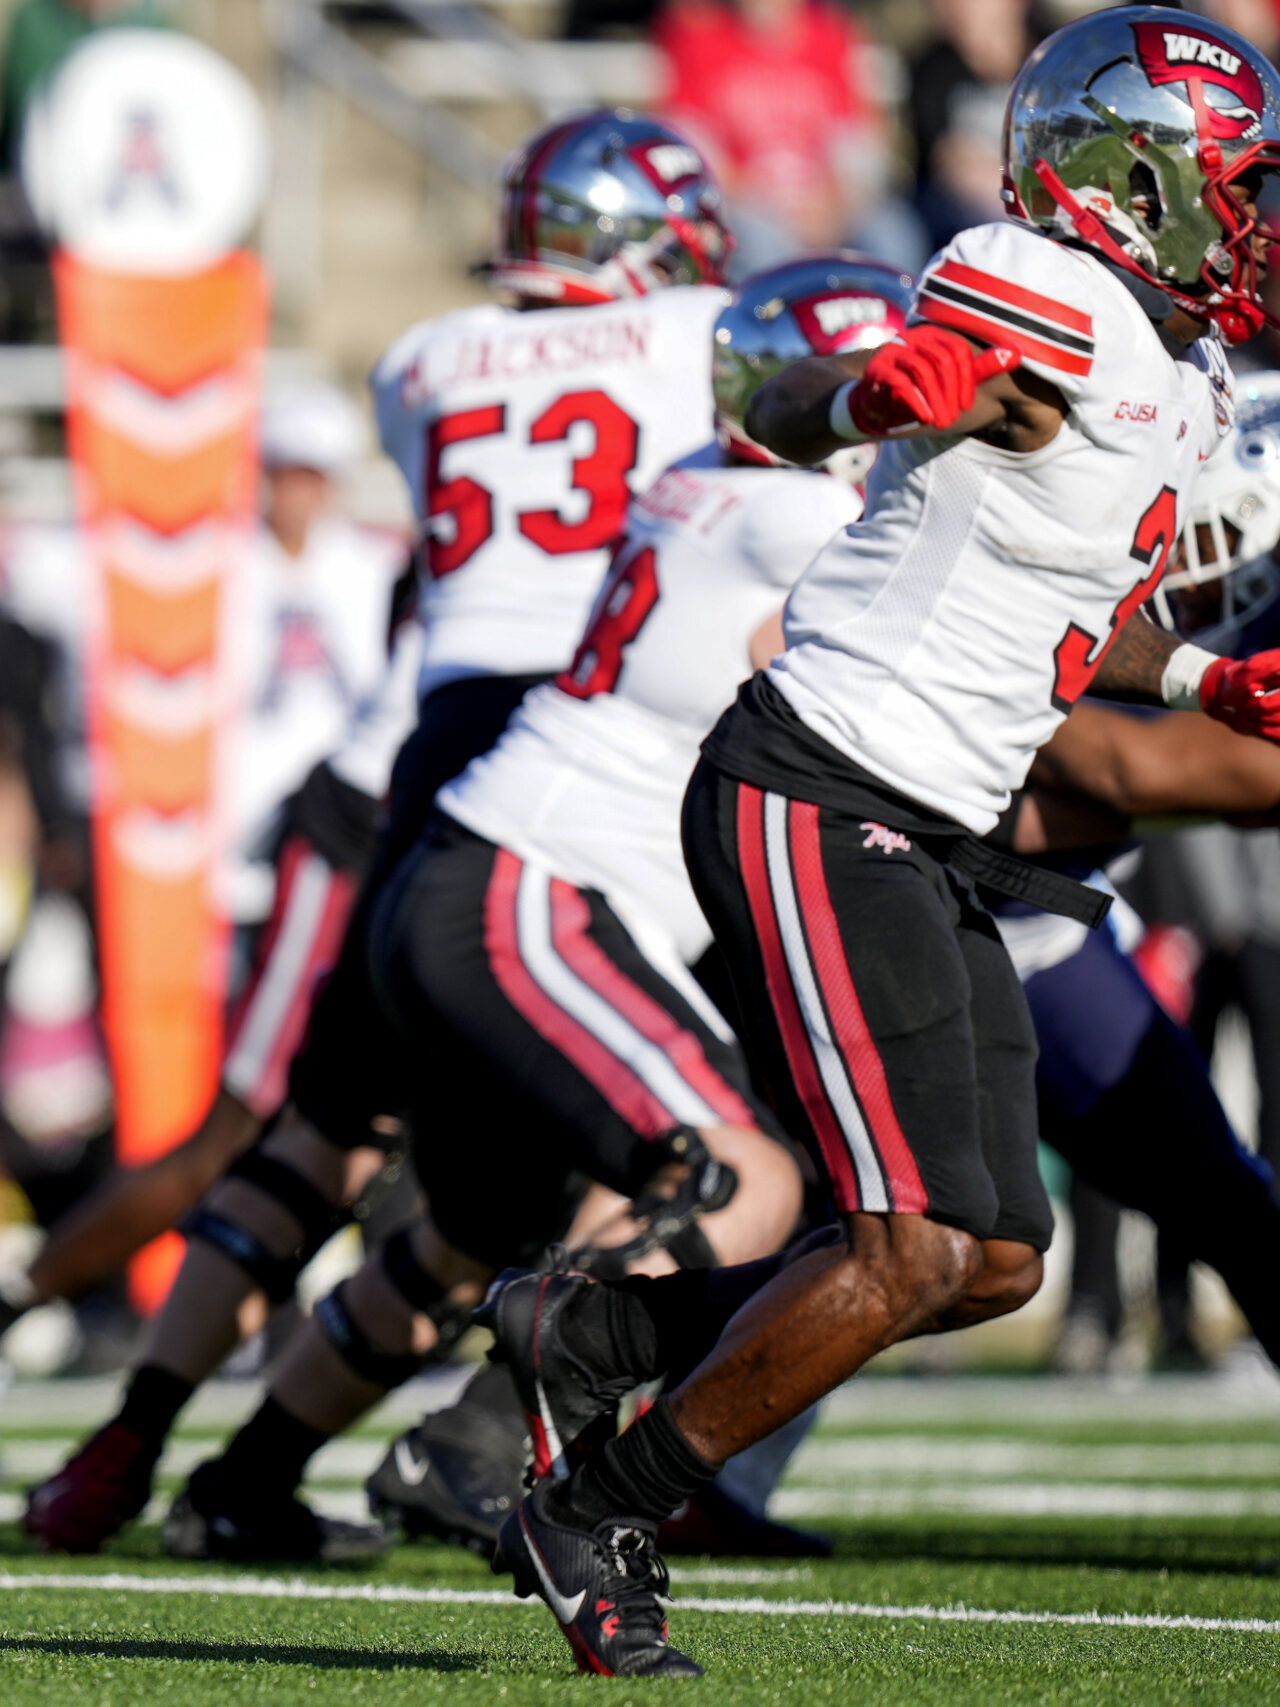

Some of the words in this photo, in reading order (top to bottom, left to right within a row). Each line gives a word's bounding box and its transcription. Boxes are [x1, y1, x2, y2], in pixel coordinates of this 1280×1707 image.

[1162, 32, 1242, 76] WKU
[444, 316, 652, 390] JACKSON
[423, 388, 640, 582] 53
[1050, 483, 1178, 716] 3
